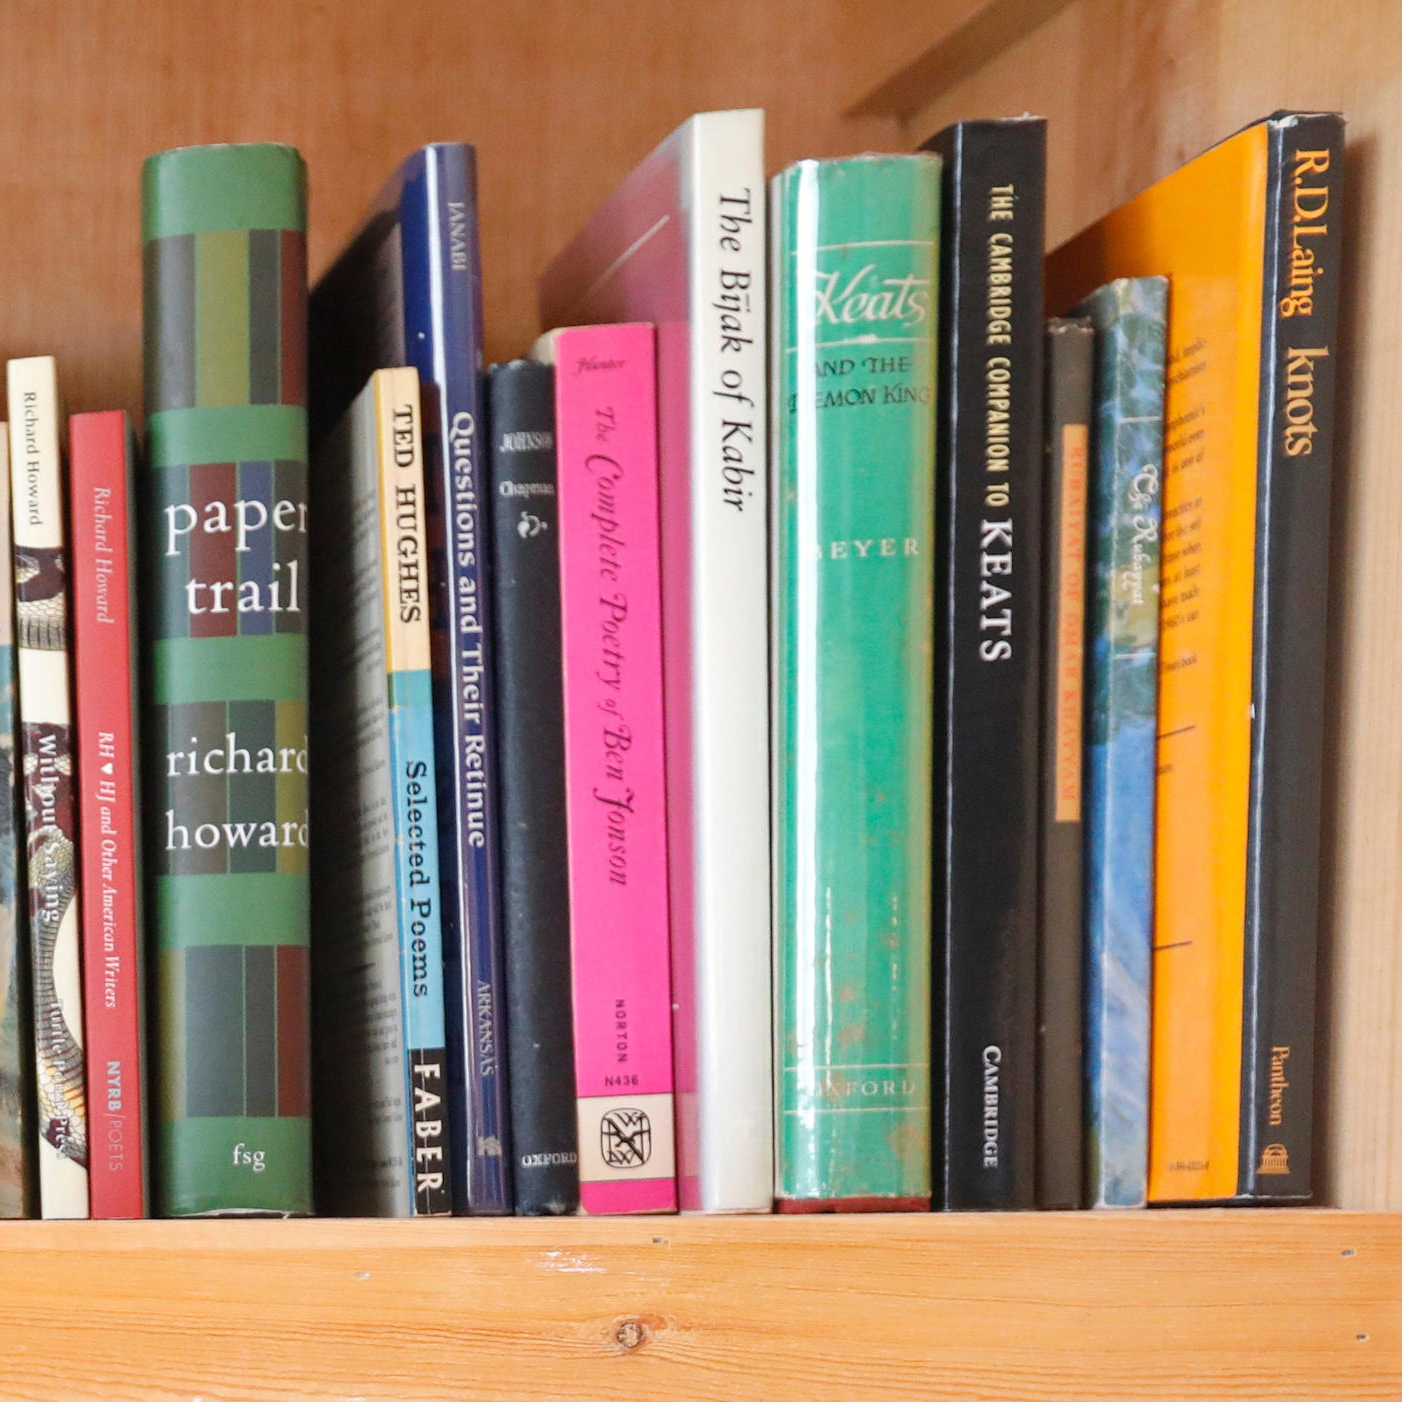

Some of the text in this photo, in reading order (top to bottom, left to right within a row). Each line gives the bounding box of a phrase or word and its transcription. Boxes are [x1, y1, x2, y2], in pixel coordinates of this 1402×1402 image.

[720, 188, 752, 251] The
[714, 369, 754, 403] of
[980, 185, 1014, 661] THE CAMBRIDGE COMPANION TO KEATS
[1285, 347, 1329, 456] knots
[24, 392, 43, 525] Richard Howard
[722, 420, 755, 511] Kabir
[394, 405, 420, 623] TED HUGHES
[414, 1064, 442, 1196] FABER
[1270, 1047, 1290, 1125] Pantheon
